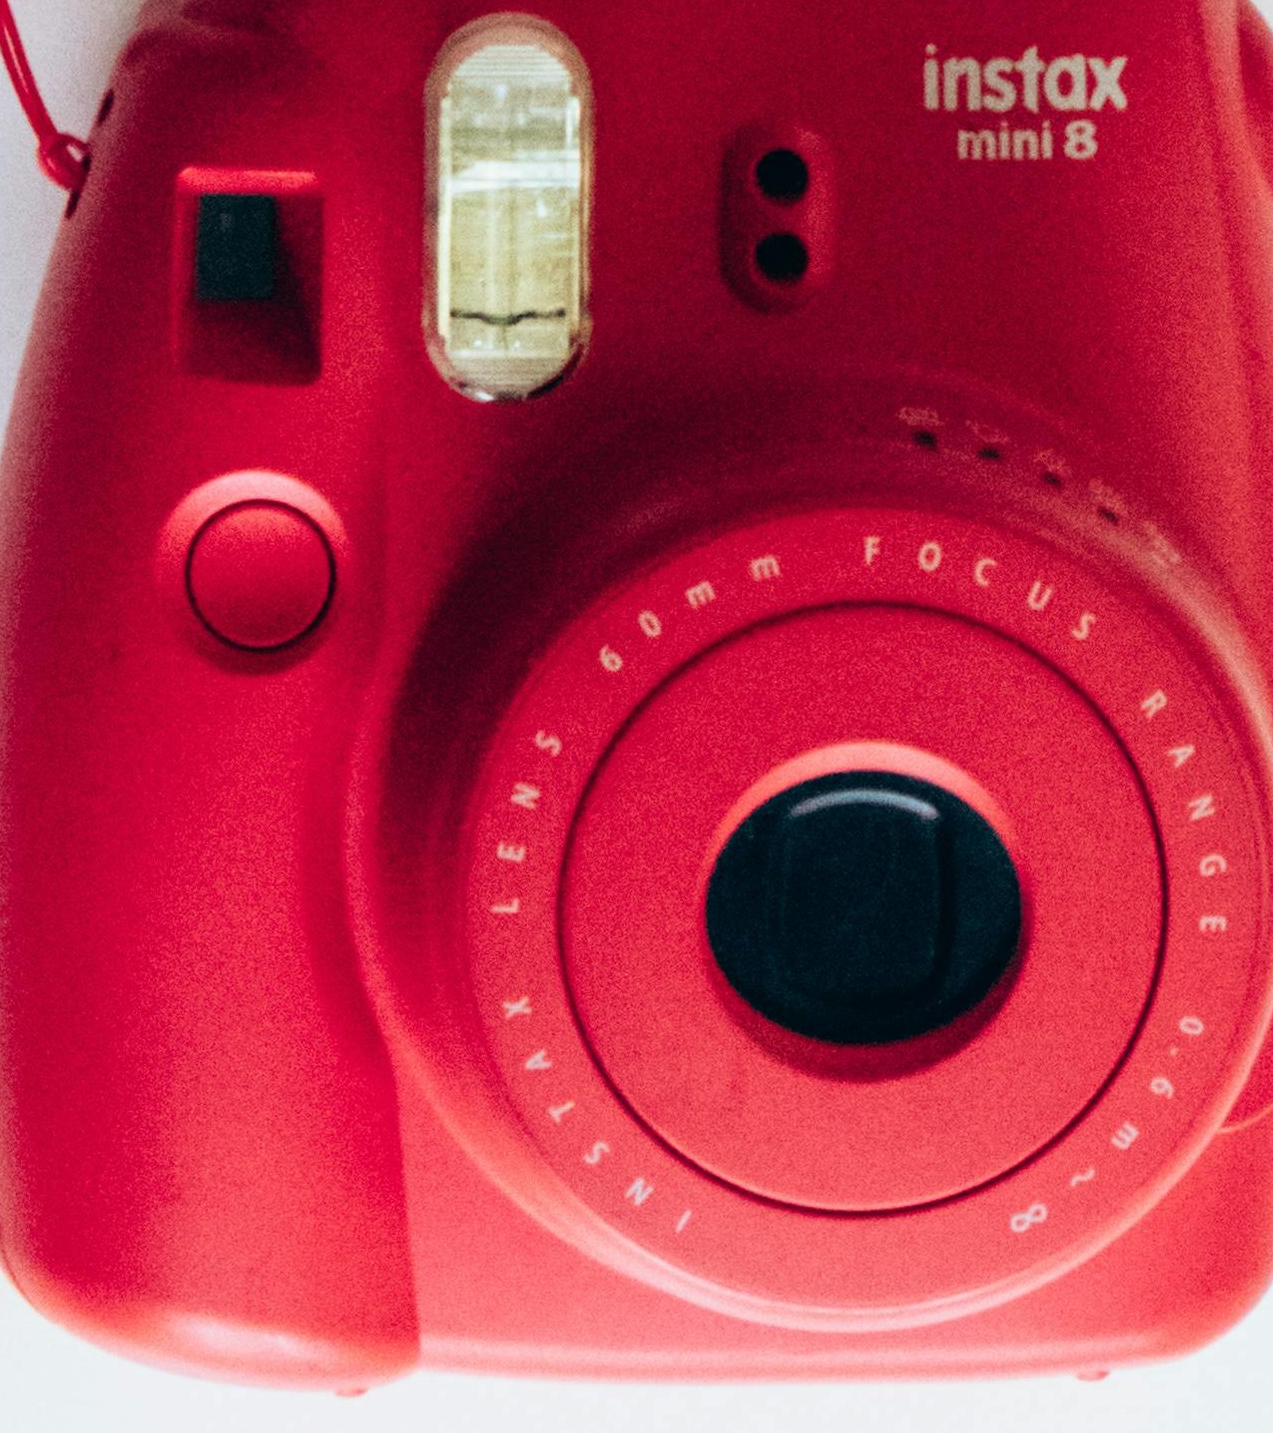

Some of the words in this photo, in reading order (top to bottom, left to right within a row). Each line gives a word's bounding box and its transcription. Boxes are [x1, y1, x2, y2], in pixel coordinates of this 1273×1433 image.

[923, 43, 1128, 114] instax
[957, 119, 1054, 161] mini
[1063, 118, 1099, 161] 8
[599, 553, 782, 674] 60mm
[863, 535, 1097, 642] FOCUS
[491, 729, 563, 915] LENS
[1141, 688, 1228, 934] RANGE
[501, 995, 693, 1235] INSTAX
